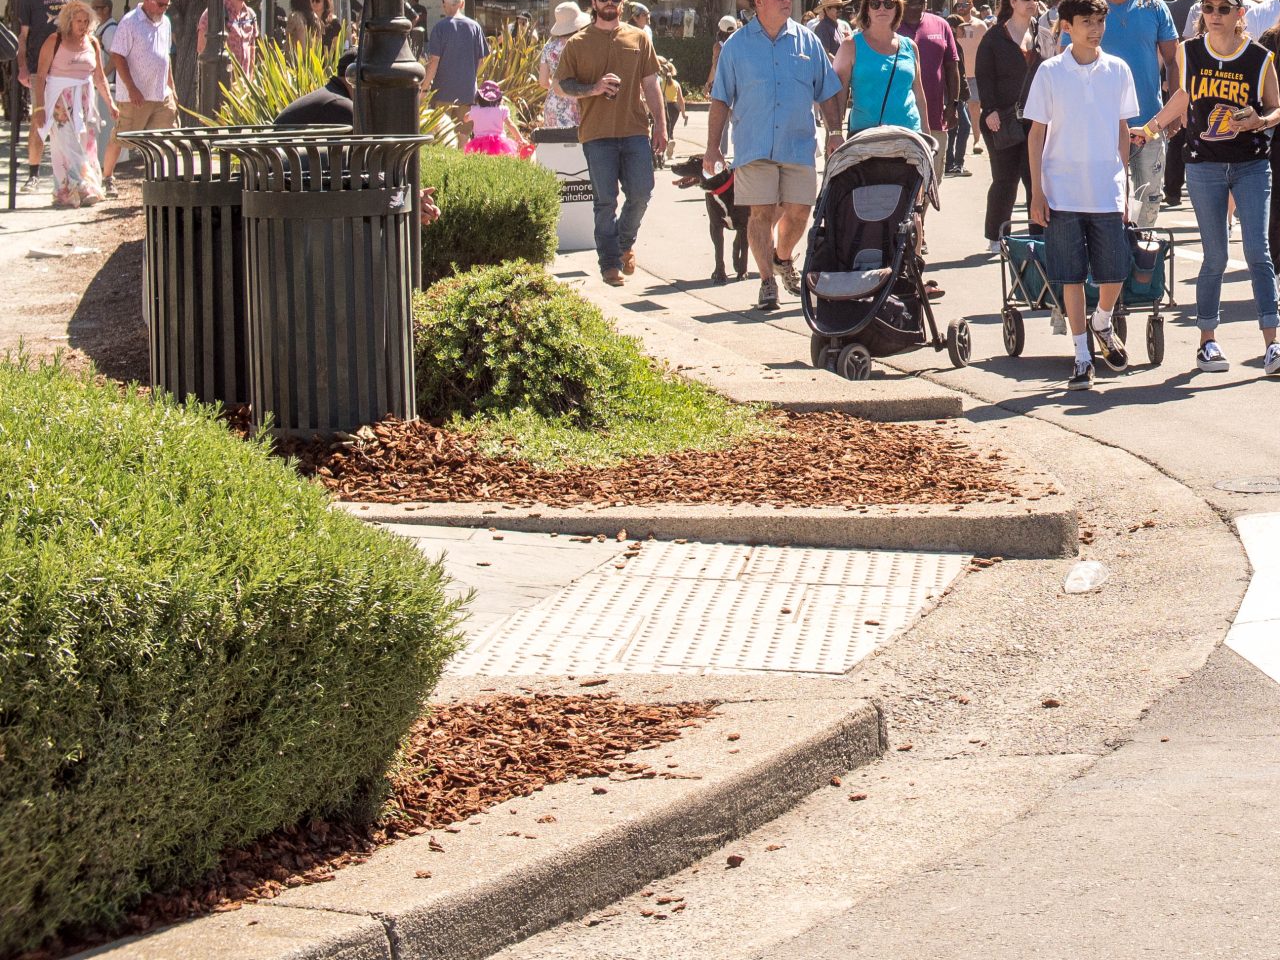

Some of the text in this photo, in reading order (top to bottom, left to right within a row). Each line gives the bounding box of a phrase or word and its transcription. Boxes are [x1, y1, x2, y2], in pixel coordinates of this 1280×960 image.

[1200, 68, 1244, 80] LOS ANGELES
[1190, 75, 1250, 108] LAKERS
[562, 192, 593, 201] nitation
